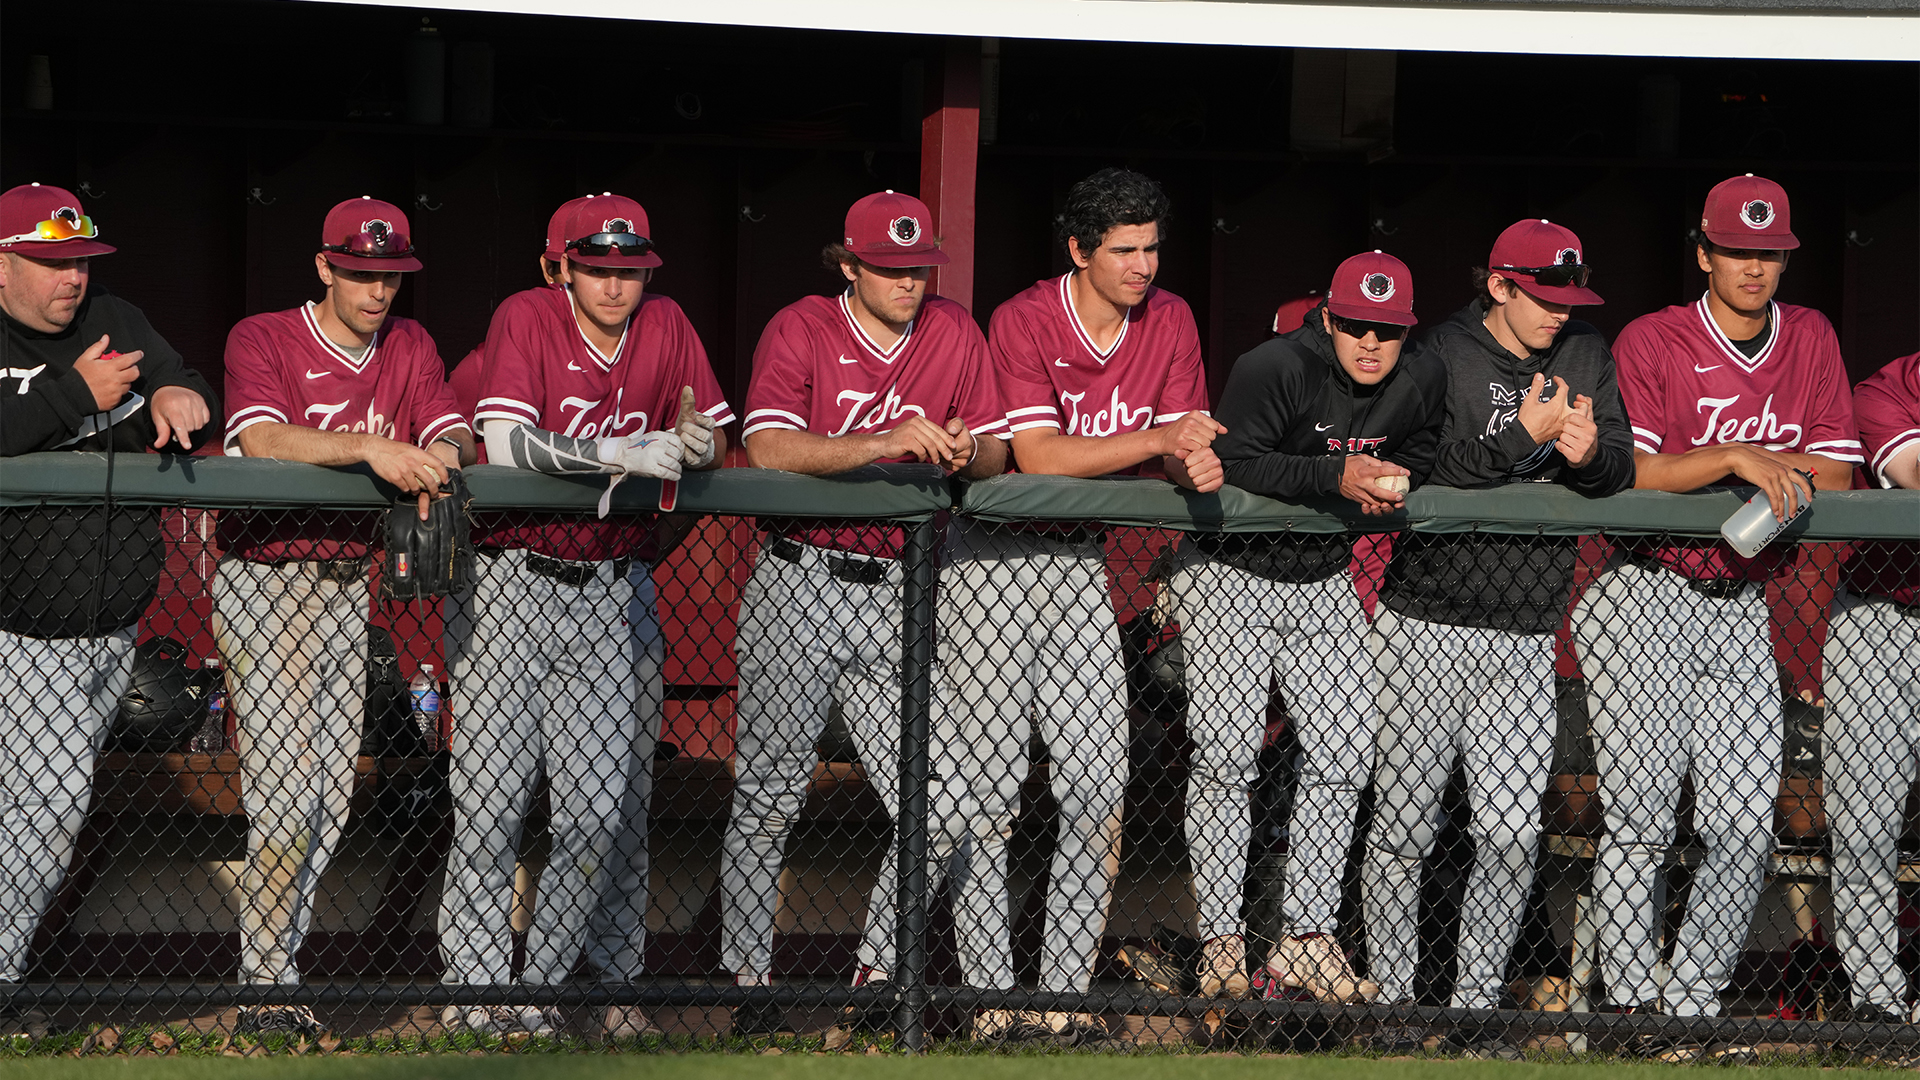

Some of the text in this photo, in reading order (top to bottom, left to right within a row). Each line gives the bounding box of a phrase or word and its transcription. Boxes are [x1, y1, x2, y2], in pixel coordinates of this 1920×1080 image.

[827, 381, 926, 438] Tch
[1060, 384, 1153, 438] Tech
[1691, 393, 1803, 452] Tech
[1327, 435, 1388, 452] MIT
[1752, 523, 1785, 553] SPORTS
